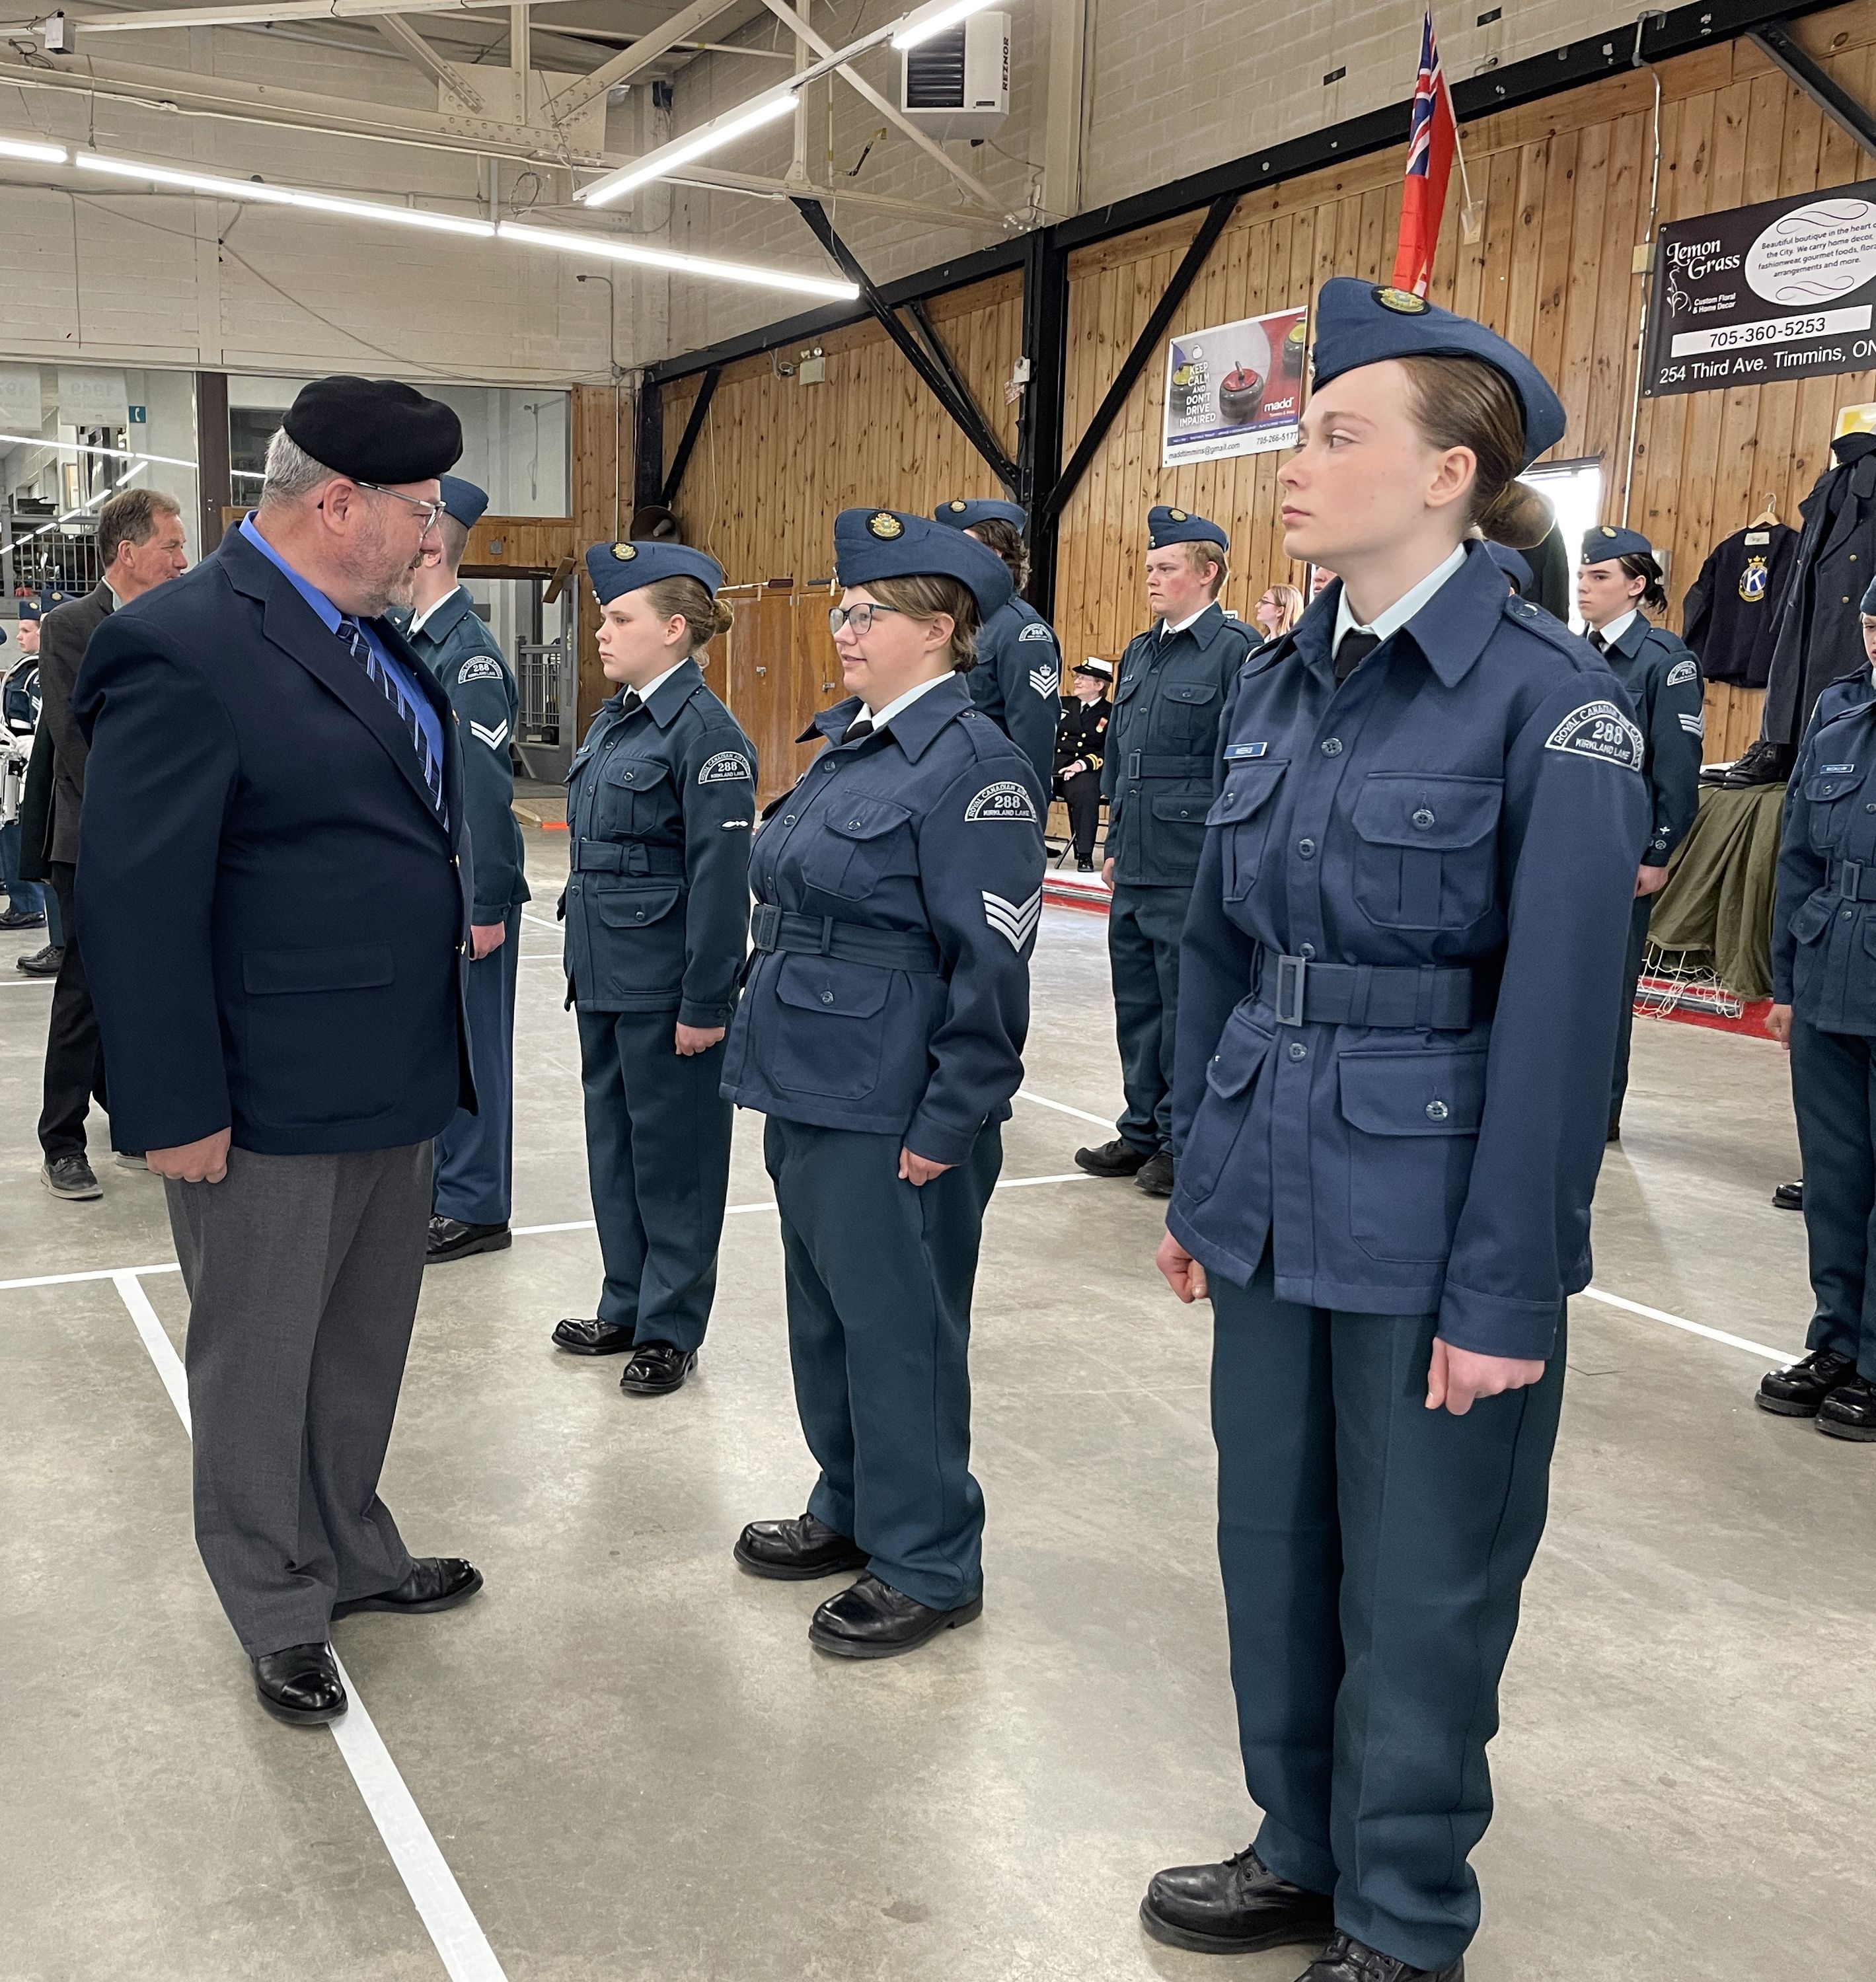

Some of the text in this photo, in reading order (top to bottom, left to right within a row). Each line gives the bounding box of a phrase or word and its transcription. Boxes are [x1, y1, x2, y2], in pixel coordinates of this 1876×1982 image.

[1761, 237, 1793, 250] Beautiful
[1795, 232, 1827, 243] boutique
[1850, 223, 1871, 232] heart
[1667, 240, 1721, 267] Lemon
[1803, 250, 1834, 264] gourmet
[1688, 254, 1741, 279] Grass
[1774, 264, 1822, 277] arrangements
[1824, 260, 1838, 268] and
[1694, 293, 1736, 306] Custom Floral
[1717, 301, 1736, 310] Decor
[1709, 317, 1826, 348] 705-360-5253
[1189, 361, 1208, 376] KEEP
[1659, 365, 1686, 384] 254
[1691, 359, 1729, 379] Third
[1733, 357, 1768, 374] Ave.
[1773, 346, 1846, 368] Timmins,
[1187, 372, 1211, 387] CALM
[1192, 385, 1206, 394] AND
[1186, 392, 1211, 406] DON'T
[1264, 396, 1294, 412] madd
[1186, 403, 1210, 416] DRIVE
[1179, 412, 1216, 427] IMPAIRED
[472, 663, 490, 673] 288
[1554, 717, 1581, 745] ROYAL
[1592, 720, 1623, 745] 288
[1575, 738, 1614, 755] KIRKLAND
[718, 761, 738, 772] 288
[968, 798, 983, 817] ROYAL
[981, 784, 1016, 798] CANADIAN
[994, 795, 1021, 809] 288
